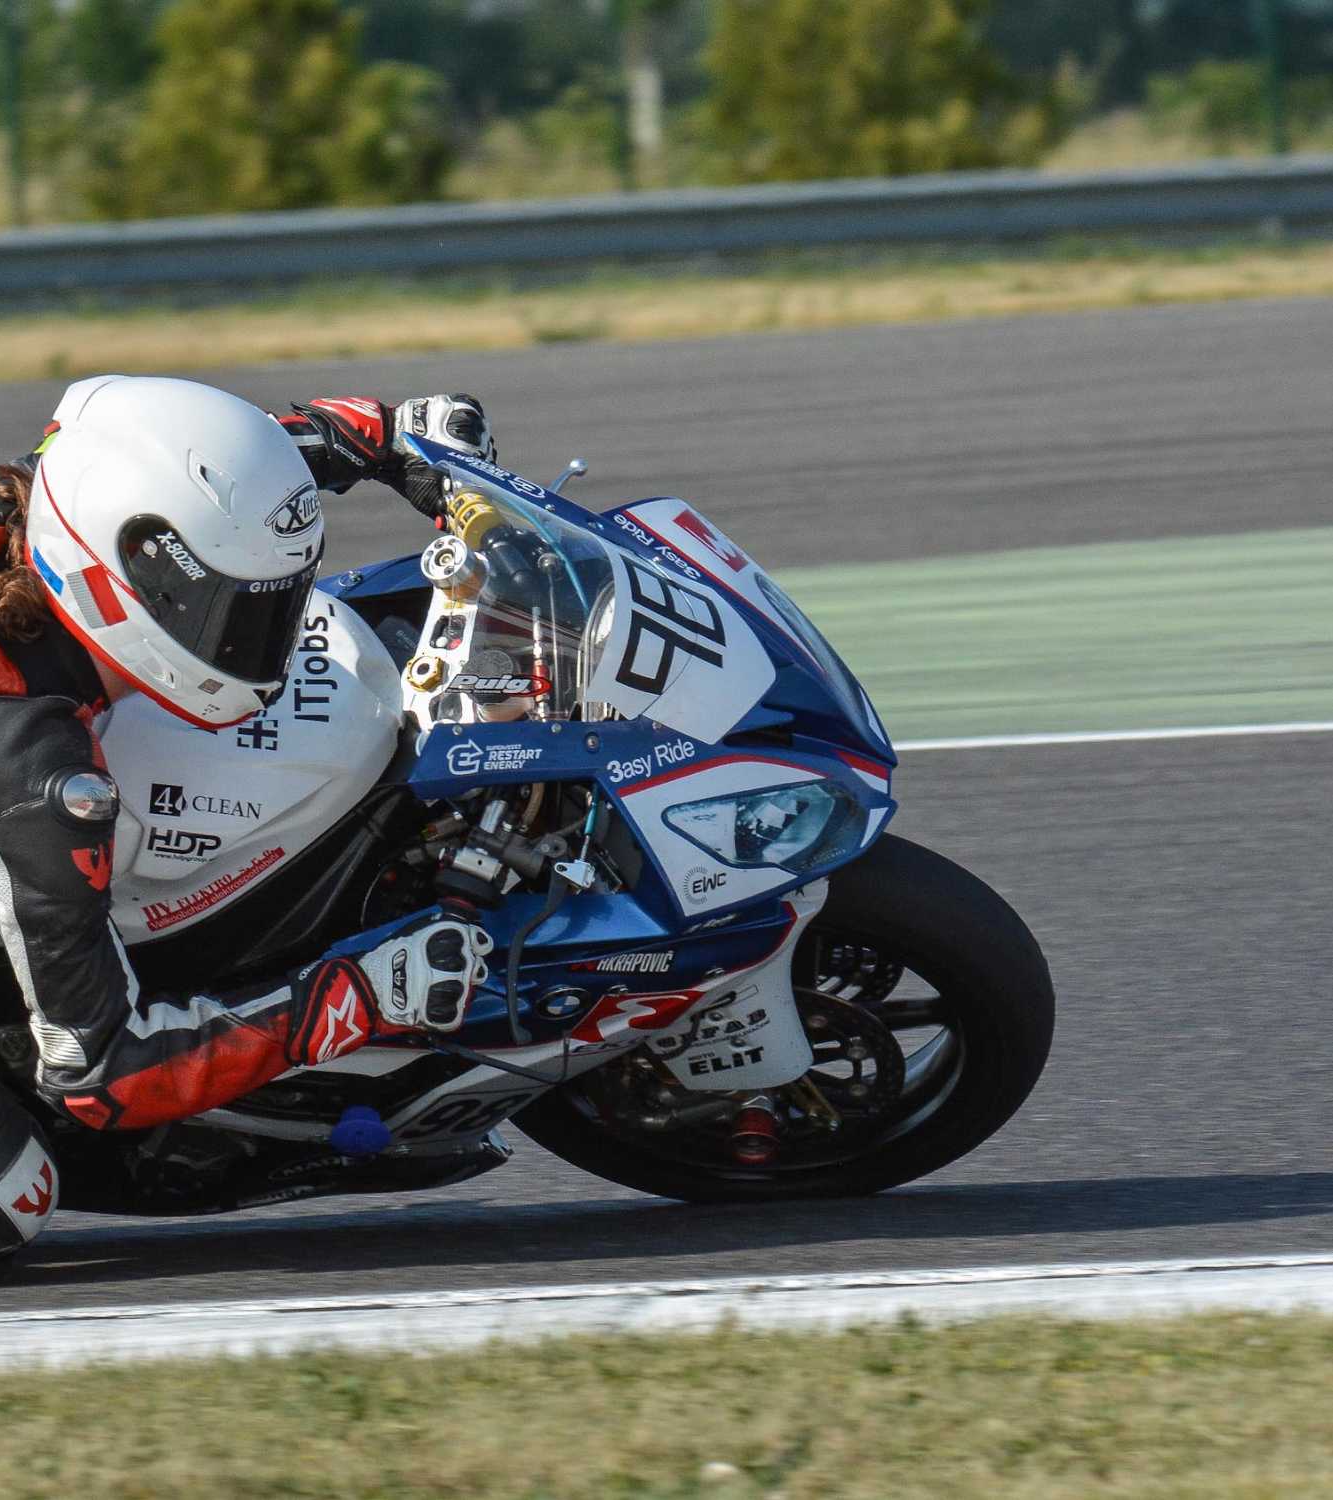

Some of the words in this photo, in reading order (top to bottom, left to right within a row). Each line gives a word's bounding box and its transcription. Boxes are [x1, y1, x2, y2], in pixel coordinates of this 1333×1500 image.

[613, 513, 655, 546] Ride
[156, 531, 206, 581] X-802RR
[249, 577, 294, 593] GIVES
[449, 673, 531, 694] Puig
[484, 759, 527, 770] ENERGY
[489, 748, 543, 761] RESTART
[606, 759, 654, 783] 3asy
[654, 739, 696, 768] Ride
[192, 795, 264, 820] CLEAN
[147, 826, 222, 857] HDP
[692, 872, 727, 894] EWC
